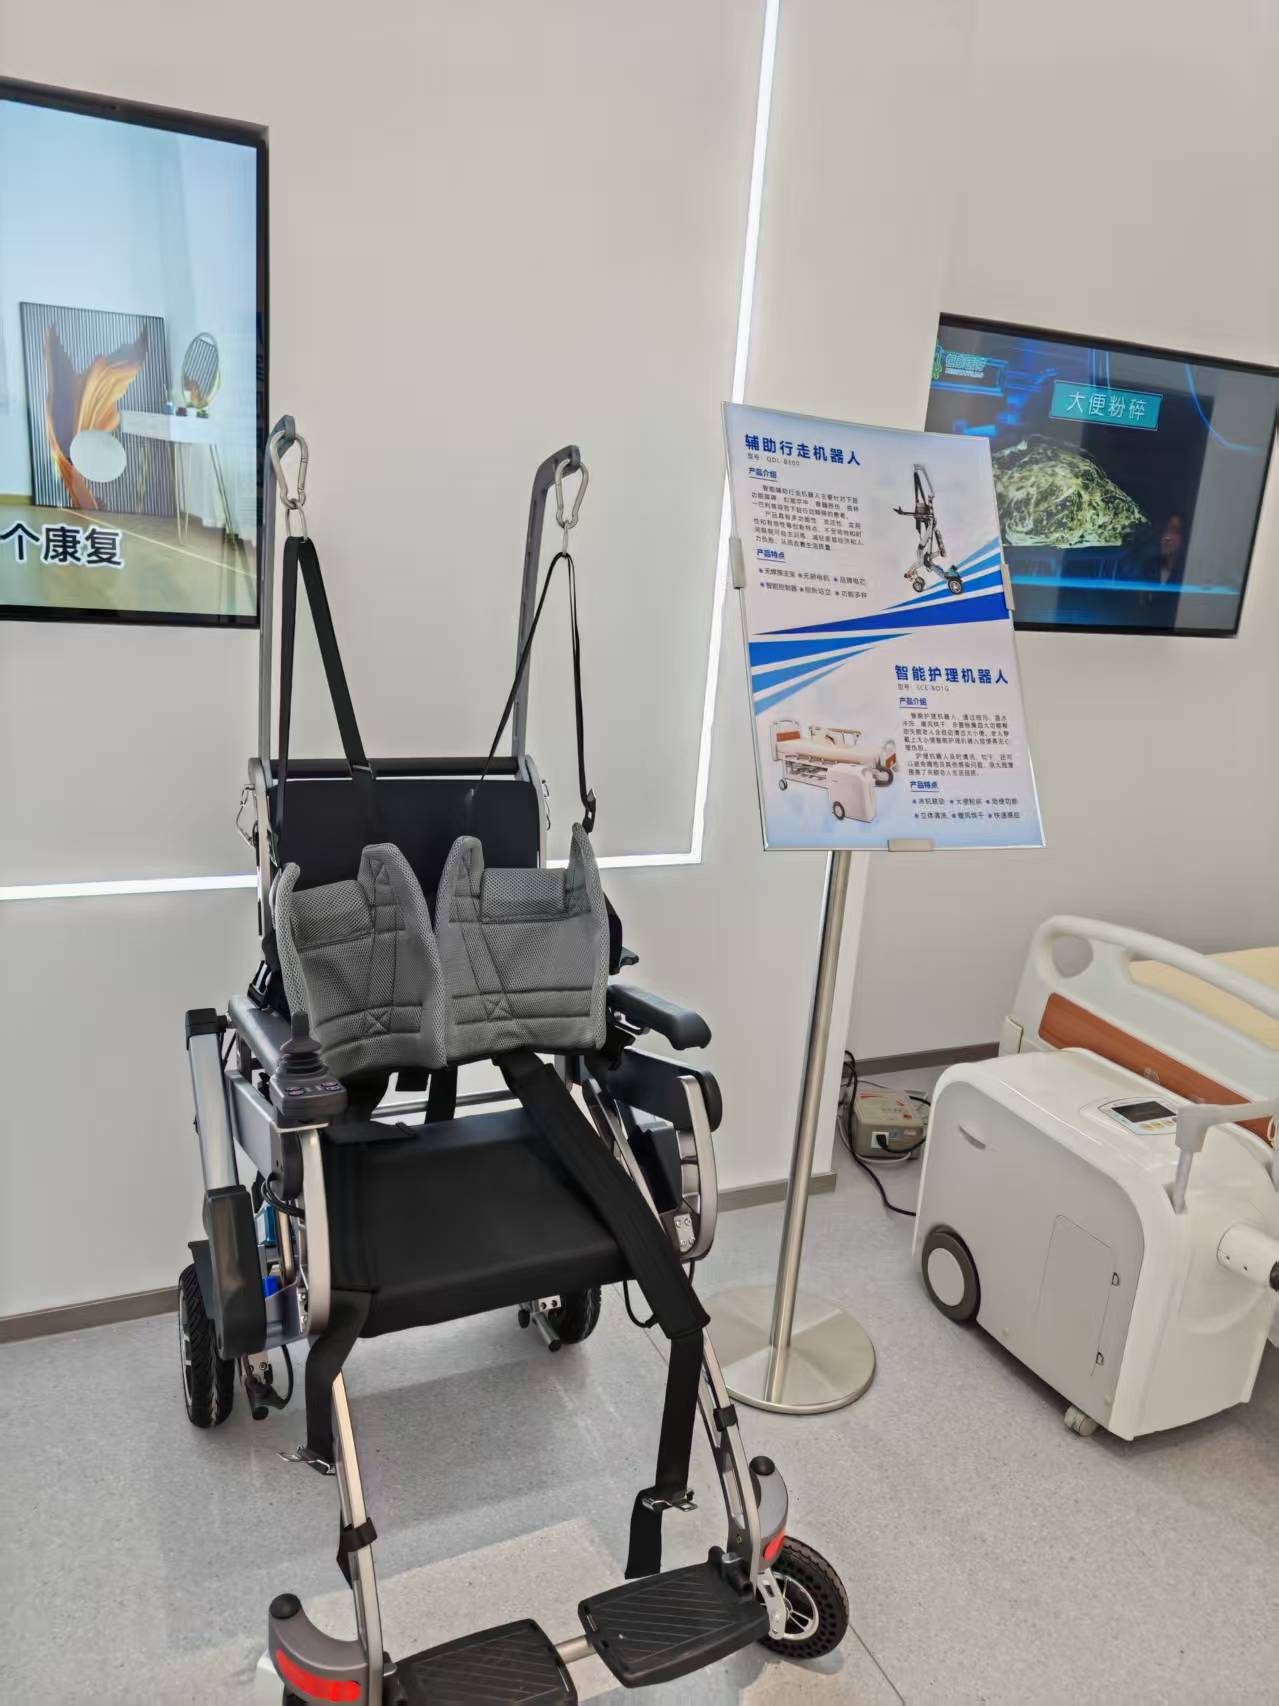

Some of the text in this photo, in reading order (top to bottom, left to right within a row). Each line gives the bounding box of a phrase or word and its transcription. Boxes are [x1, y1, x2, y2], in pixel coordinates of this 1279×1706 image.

[1065, 391, 1147, 421] 大便粉碎
[745, 434, 861, 466] 辅助行走机器人
[748, 467, 777, 479] 产品介绍
[0, 522, 122, 567] 个康复
[756, 549, 785, 560] 产品特点
[895, 665, 1009, 685] 智能护理机器人
[899, 697, 928, 706] 产品介绍
[910, 780, 939, 790] 产品特点
